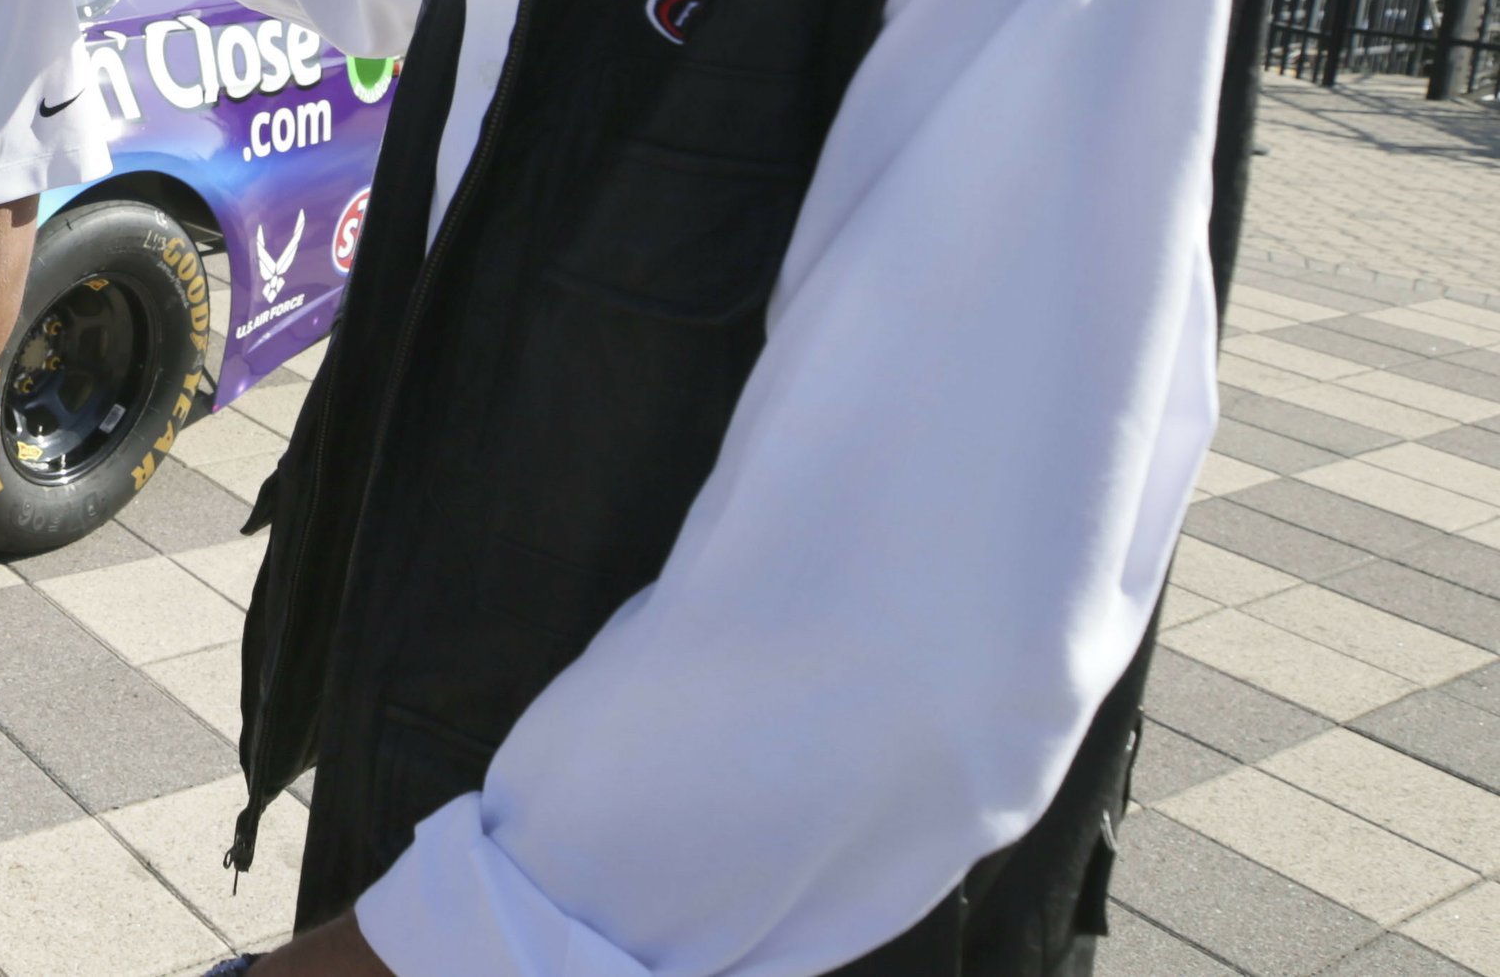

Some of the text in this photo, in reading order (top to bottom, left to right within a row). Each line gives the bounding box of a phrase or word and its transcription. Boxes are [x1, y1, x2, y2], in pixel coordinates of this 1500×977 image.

[145, 15, 322, 109] Close
[243, 99, 331, 162] .com
[253, 310, 270, 329] AIR
[270, 294, 305, 320] FORCE
[131, 237, 209, 491] GOODYEAR
